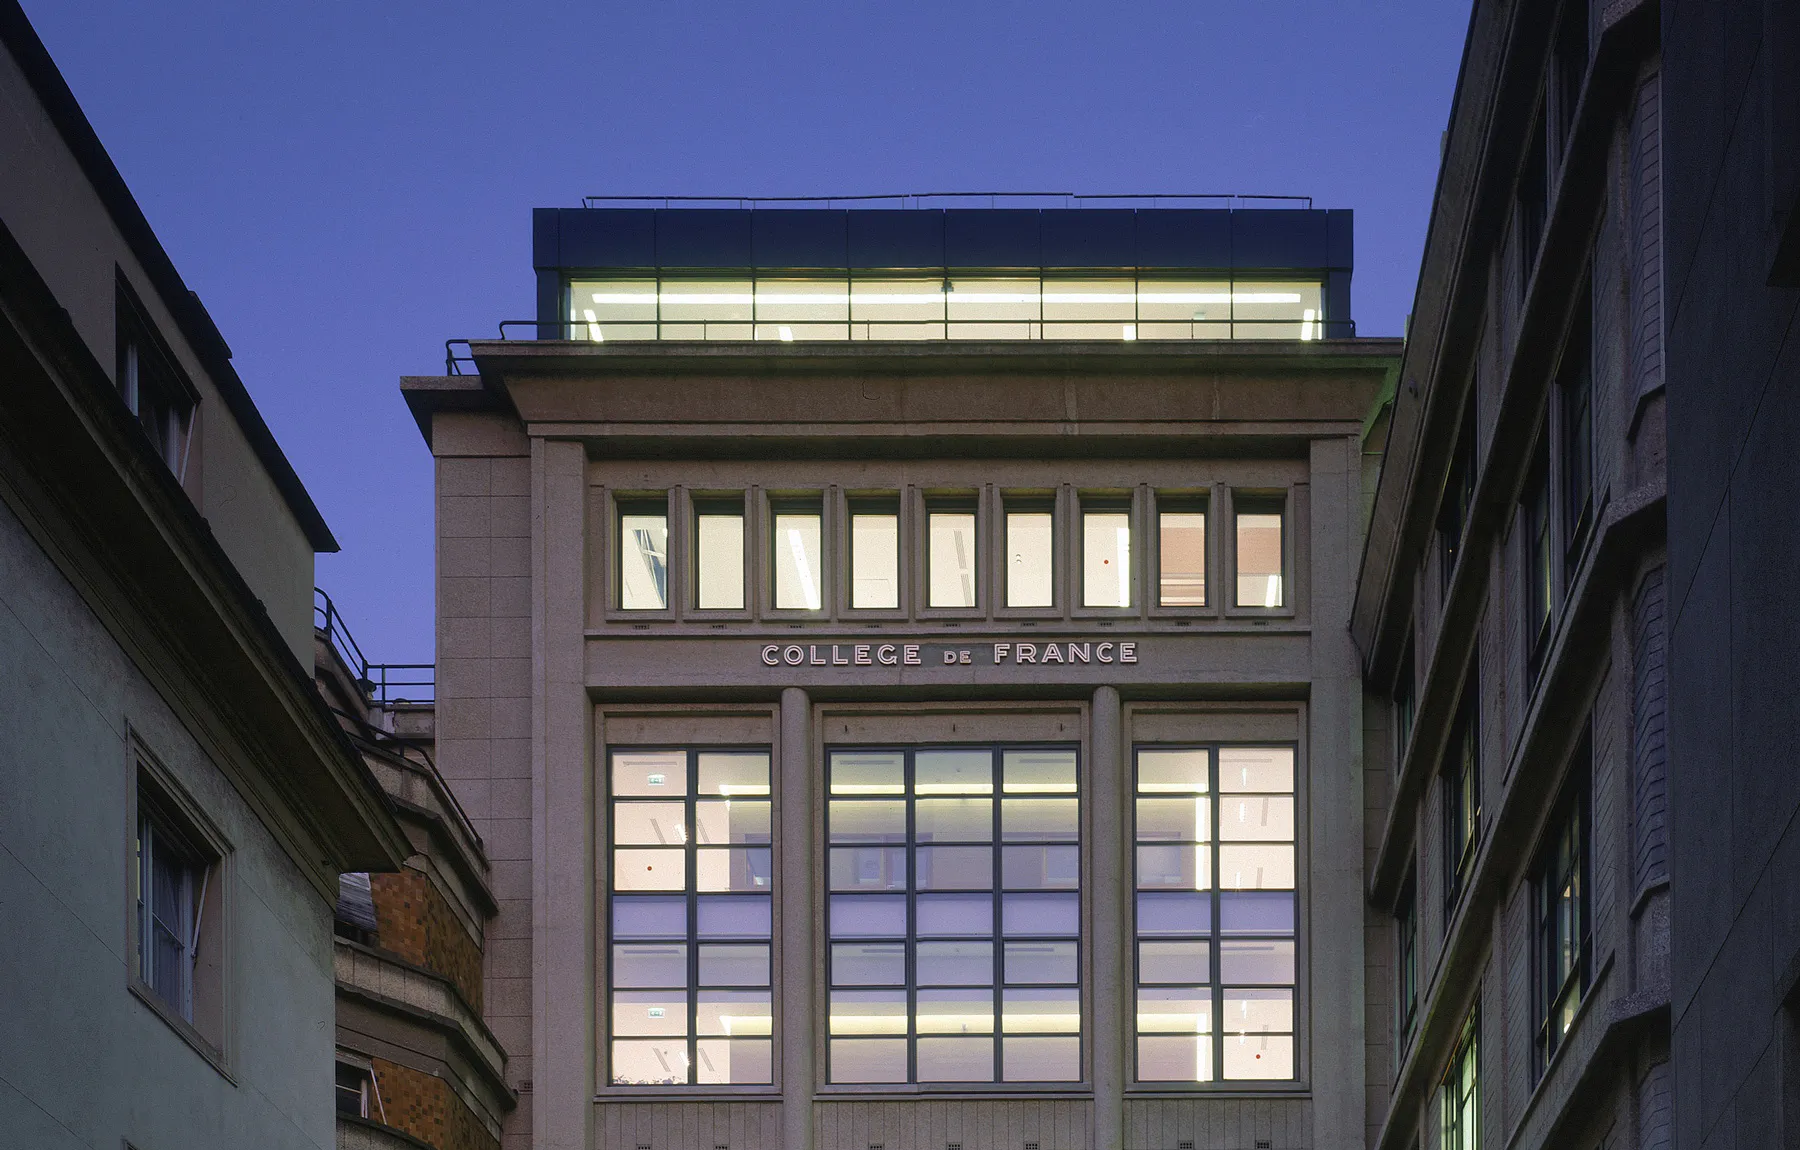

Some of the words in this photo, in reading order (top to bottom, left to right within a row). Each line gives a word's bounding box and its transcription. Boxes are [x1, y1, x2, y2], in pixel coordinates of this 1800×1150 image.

[761, 644, 922, 665] COLLEGE
[943, 650, 972, 664] DE
[994, 642, 1138, 664] FRANCE
